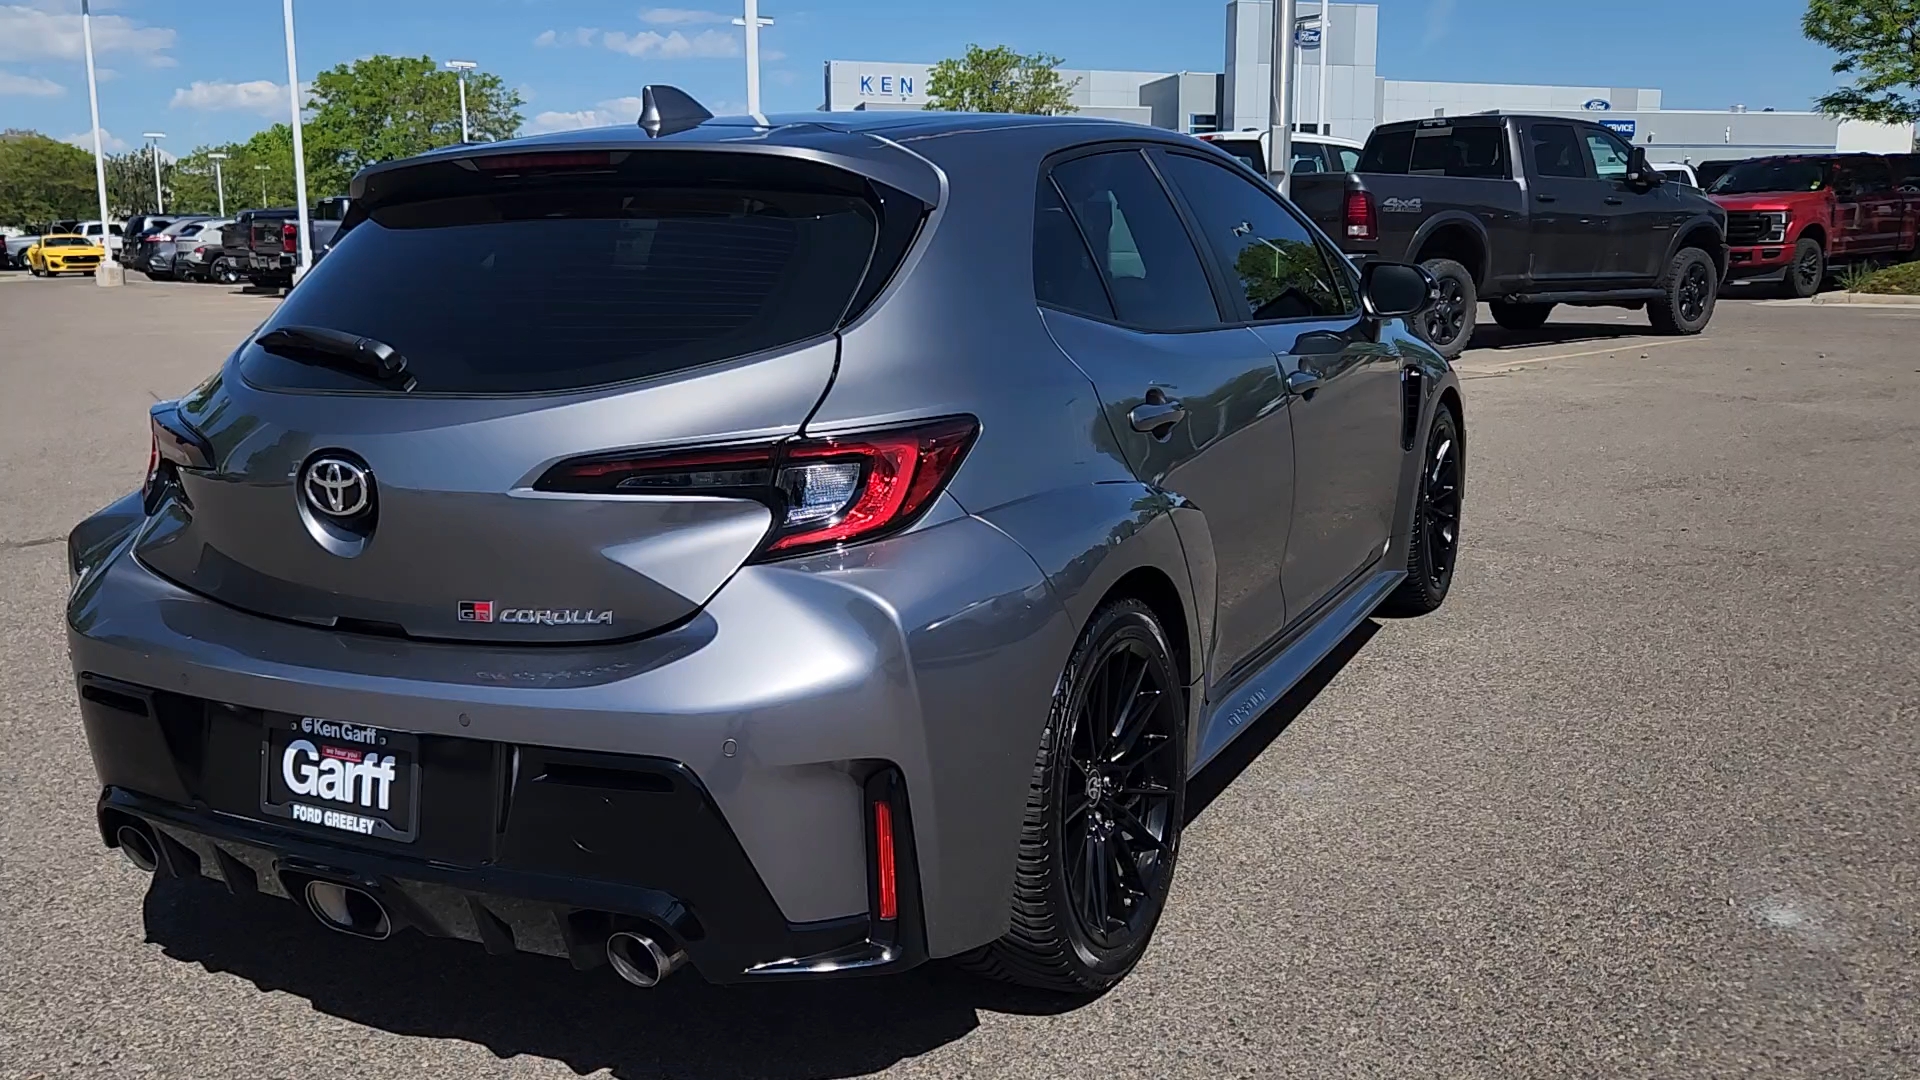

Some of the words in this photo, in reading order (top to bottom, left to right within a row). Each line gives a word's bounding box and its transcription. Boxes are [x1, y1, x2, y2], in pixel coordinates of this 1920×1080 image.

[860, 75, 914, 95] KEN
[1604, 123, 1634, 132] RVICE
[1383, 197, 1422, 208] 4x4
[461, 609, 490, 621] GR
[500, 608, 614, 625] COROLLA
[313, 718, 341, 739] Ken
[341, 724, 377, 744] Garff
[282, 739, 396, 810] Garff
[293, 804, 322, 824] FORD
[323, 810, 375, 835] GREELEY
